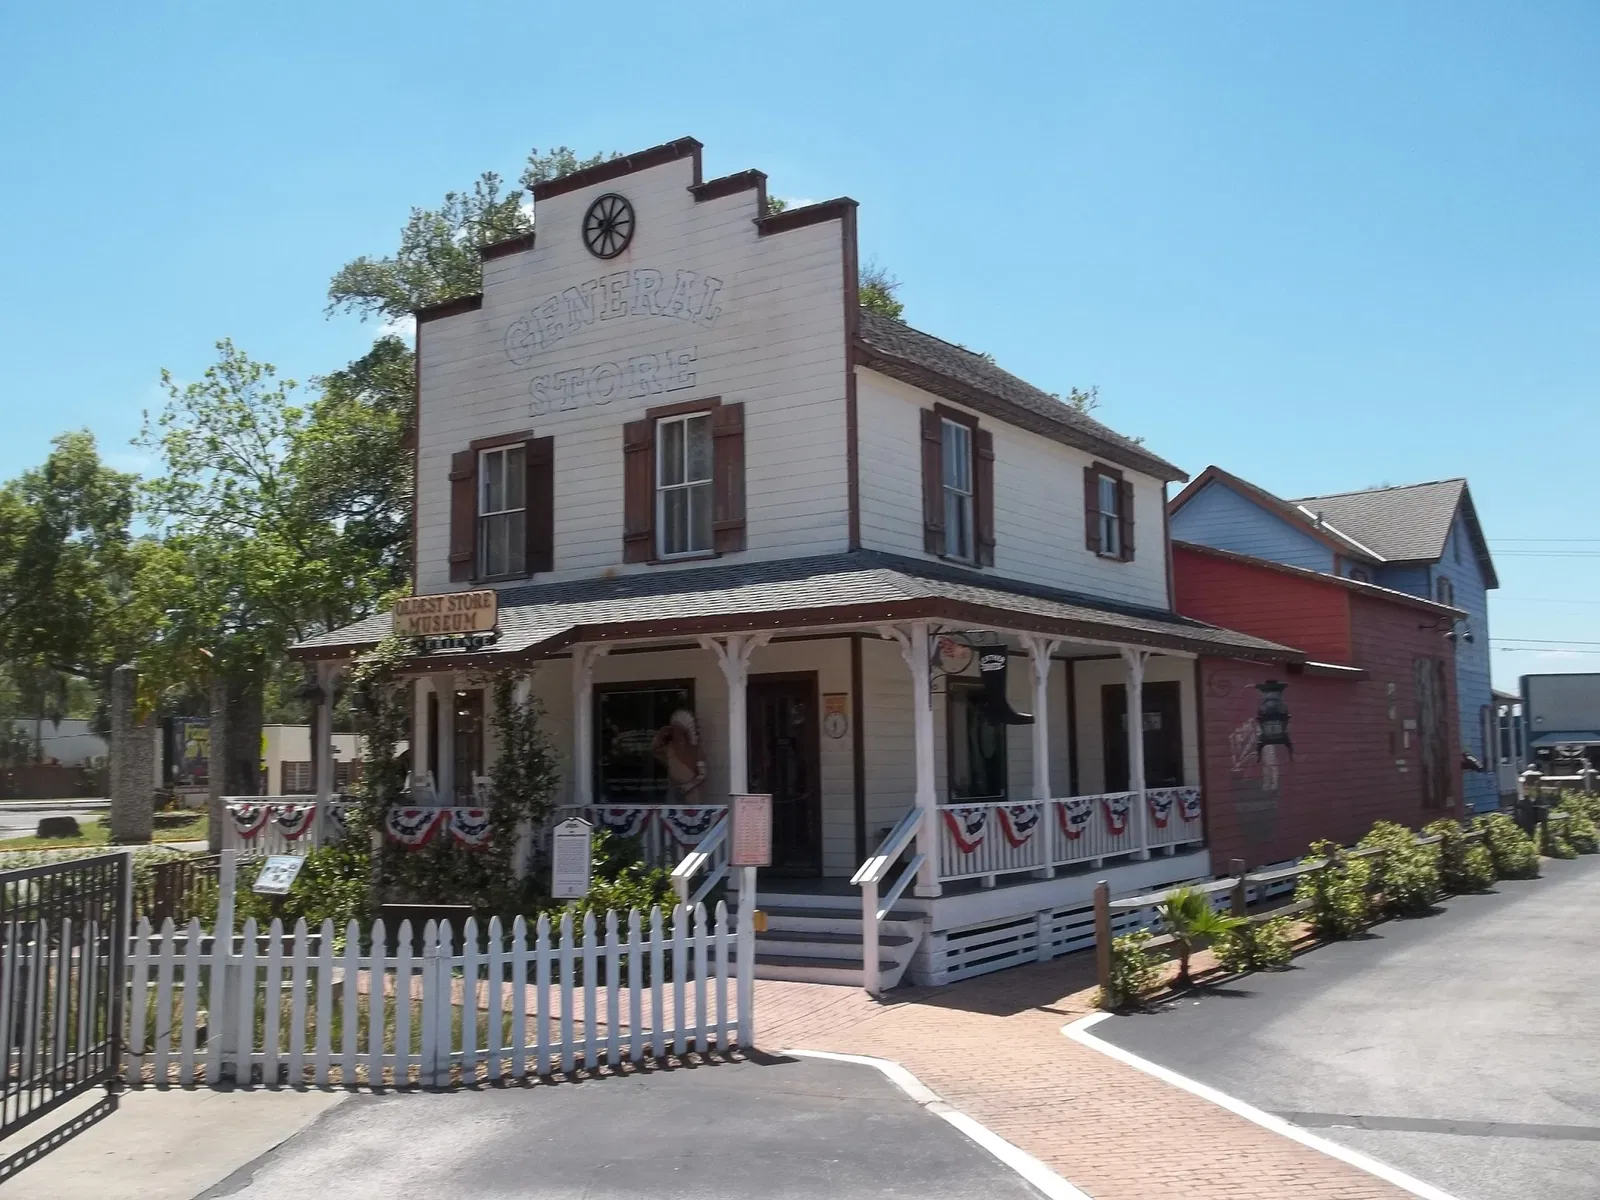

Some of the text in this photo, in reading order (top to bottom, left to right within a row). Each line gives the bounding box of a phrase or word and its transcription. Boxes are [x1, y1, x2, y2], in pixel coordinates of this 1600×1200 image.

[503, 268, 724, 366] GENERAL
[528, 346, 698, 418] STORE
[408, 612, 477, 633] MUSEUM
[447, 592, 490, 611] STORE
